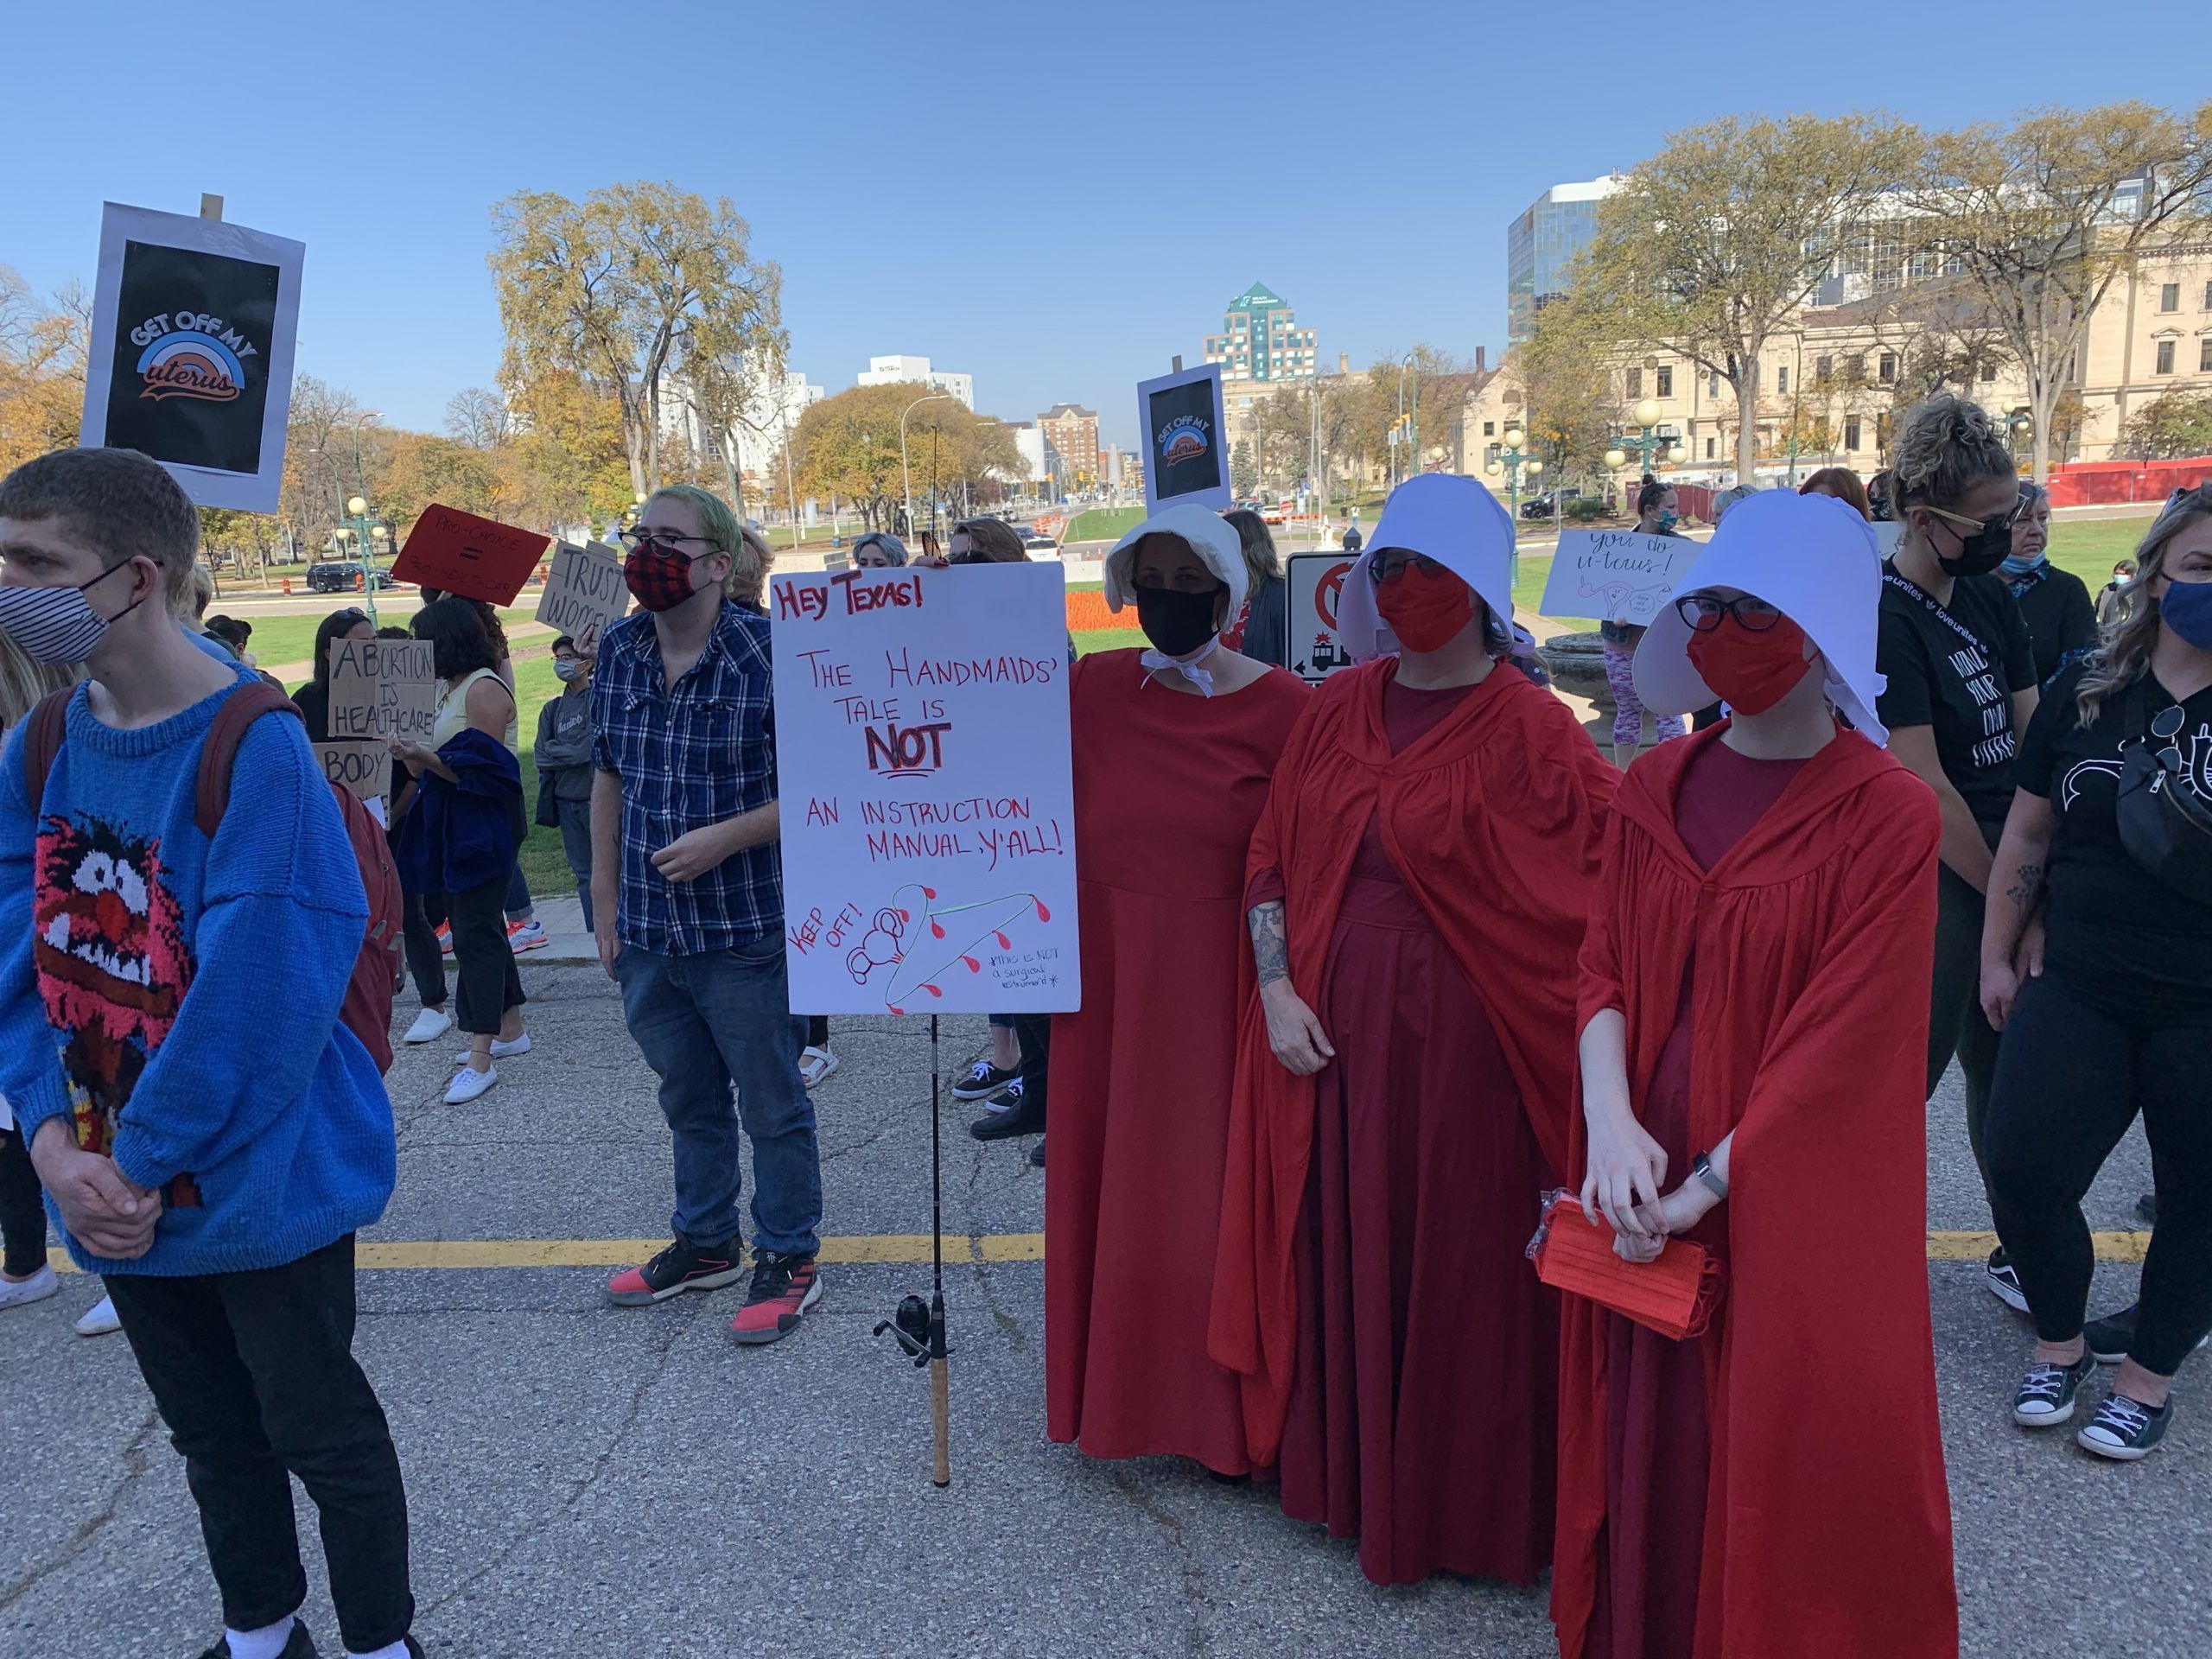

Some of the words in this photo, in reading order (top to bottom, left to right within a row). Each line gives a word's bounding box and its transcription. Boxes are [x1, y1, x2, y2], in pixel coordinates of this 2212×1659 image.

[130, 313, 171, 346] GET
[175, 311, 222, 333] OFF
[218, 327, 257, 358] MY
[147, 360, 232, 391] uterus
[1158, 423, 1173, 443] GET
[1173, 415, 1193, 427] OFF
[1193, 416, 1210, 431] MY
[1167, 442, 1202, 457] uterus
[1590, 532, 1636, 554] you
[1647, 536, 1675, 554] do
[563, 549, 624, 606] TRUST
[773, 581, 829, 621] HEY
[830, 569, 923, 615] TEXAS!
[333, 640, 433, 679] ABORTION
[796, 649, 853, 688] THE
[886, 646, 1058, 688] HANDMAIDS'
[380, 683, 399, 708] IS
[1966, 674, 2002, 707] YOUR
[335, 706, 433, 735] HEALTHCARE
[833, 696, 901, 724] TALE
[923, 699, 944, 720] IS
[1983, 702, 2006, 736] OWN
[864, 721, 952, 770] NOT
[1973, 730, 2016, 767] UTERUS
[324, 751, 385, 783] BODY
[807, 797, 838, 827] AN
[861, 797, 1030, 827] INSTRUCTION
[787, 907, 824, 956] KEEP
[826, 902, 863, 948] OFF!
[1037, 948, 1059, 960] NOT
[992, 969, 1001, 978] a
[1004, 963, 1045, 982] surgical
